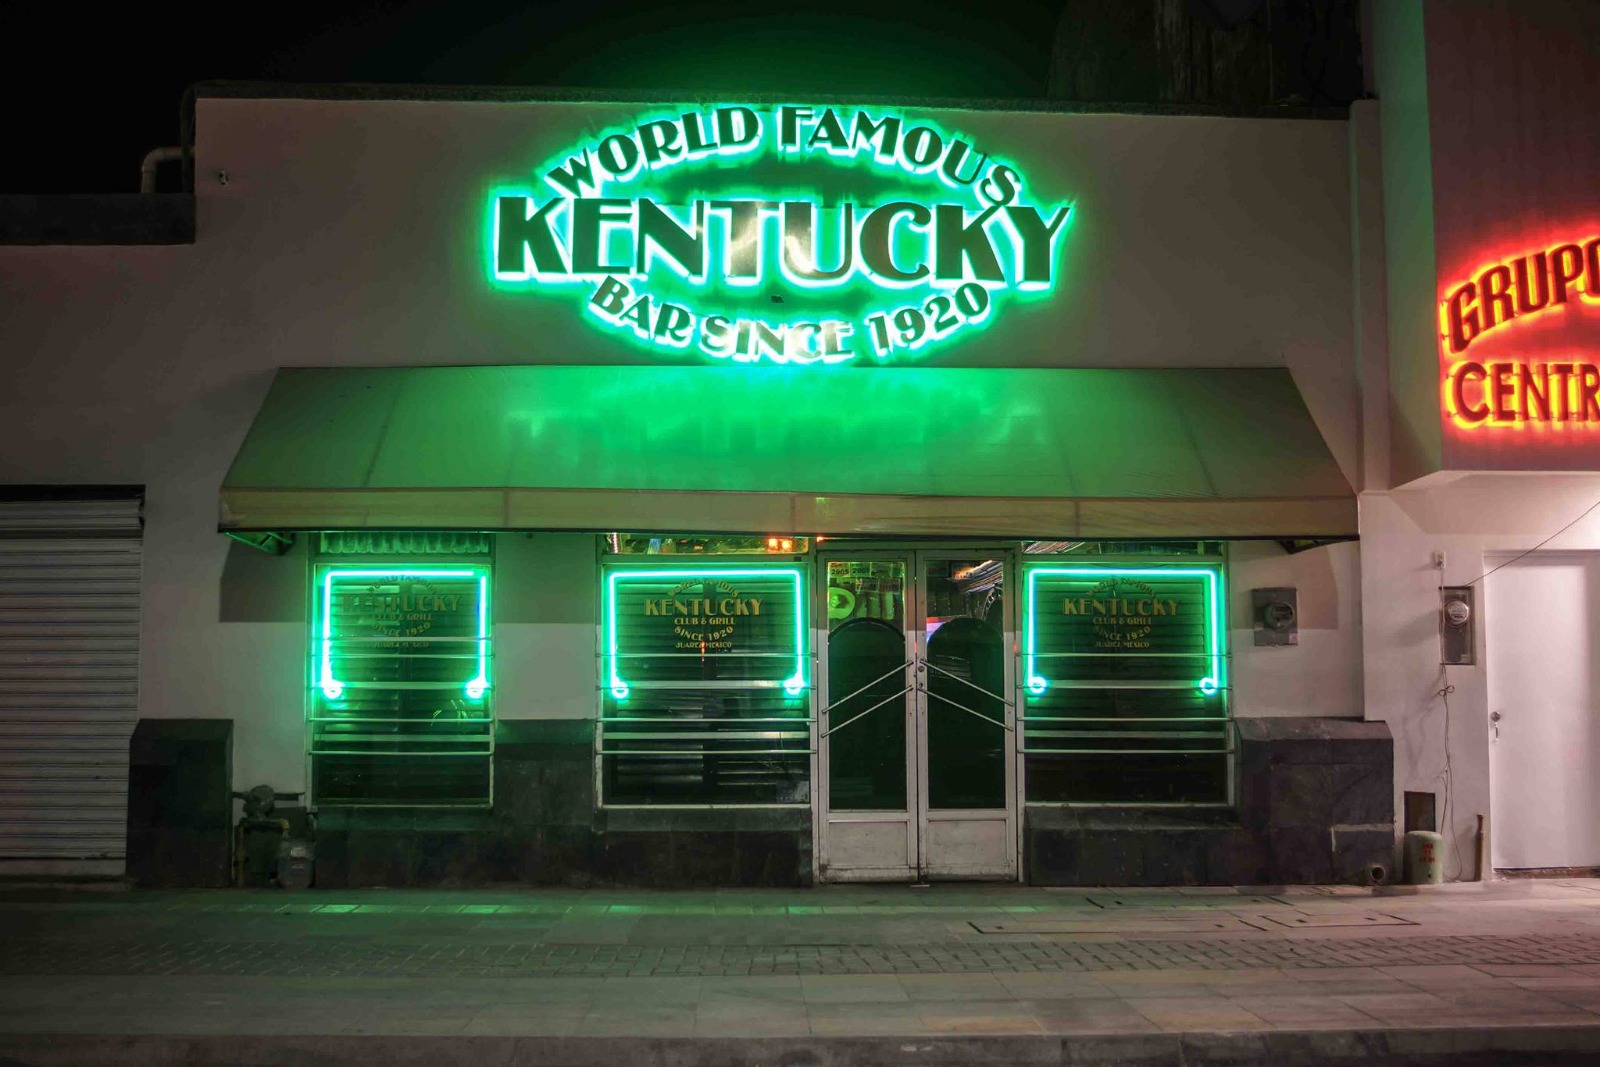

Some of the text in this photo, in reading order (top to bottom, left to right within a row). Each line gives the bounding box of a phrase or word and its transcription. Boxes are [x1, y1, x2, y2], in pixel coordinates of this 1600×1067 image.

[546, 105, 1021, 206] WORLD FAMOUS
[497, 196, 1071, 283] KENTUCKY
[590, 274, 989, 359] BAR SINCE 1920
[643, 599, 763, 616] KENTUCKY
[1062, 598, 1180, 616] KENTUCKY
[674, 617, 699, 625] CLUB
[708, 617, 736, 625] GRILL
[1093, 617, 1117, 625] CLUB
[1127, 617, 1154, 625] GRILL
[674, 625, 734, 641] SINCE 1920
[1126, 625, 1151, 641] 1920
